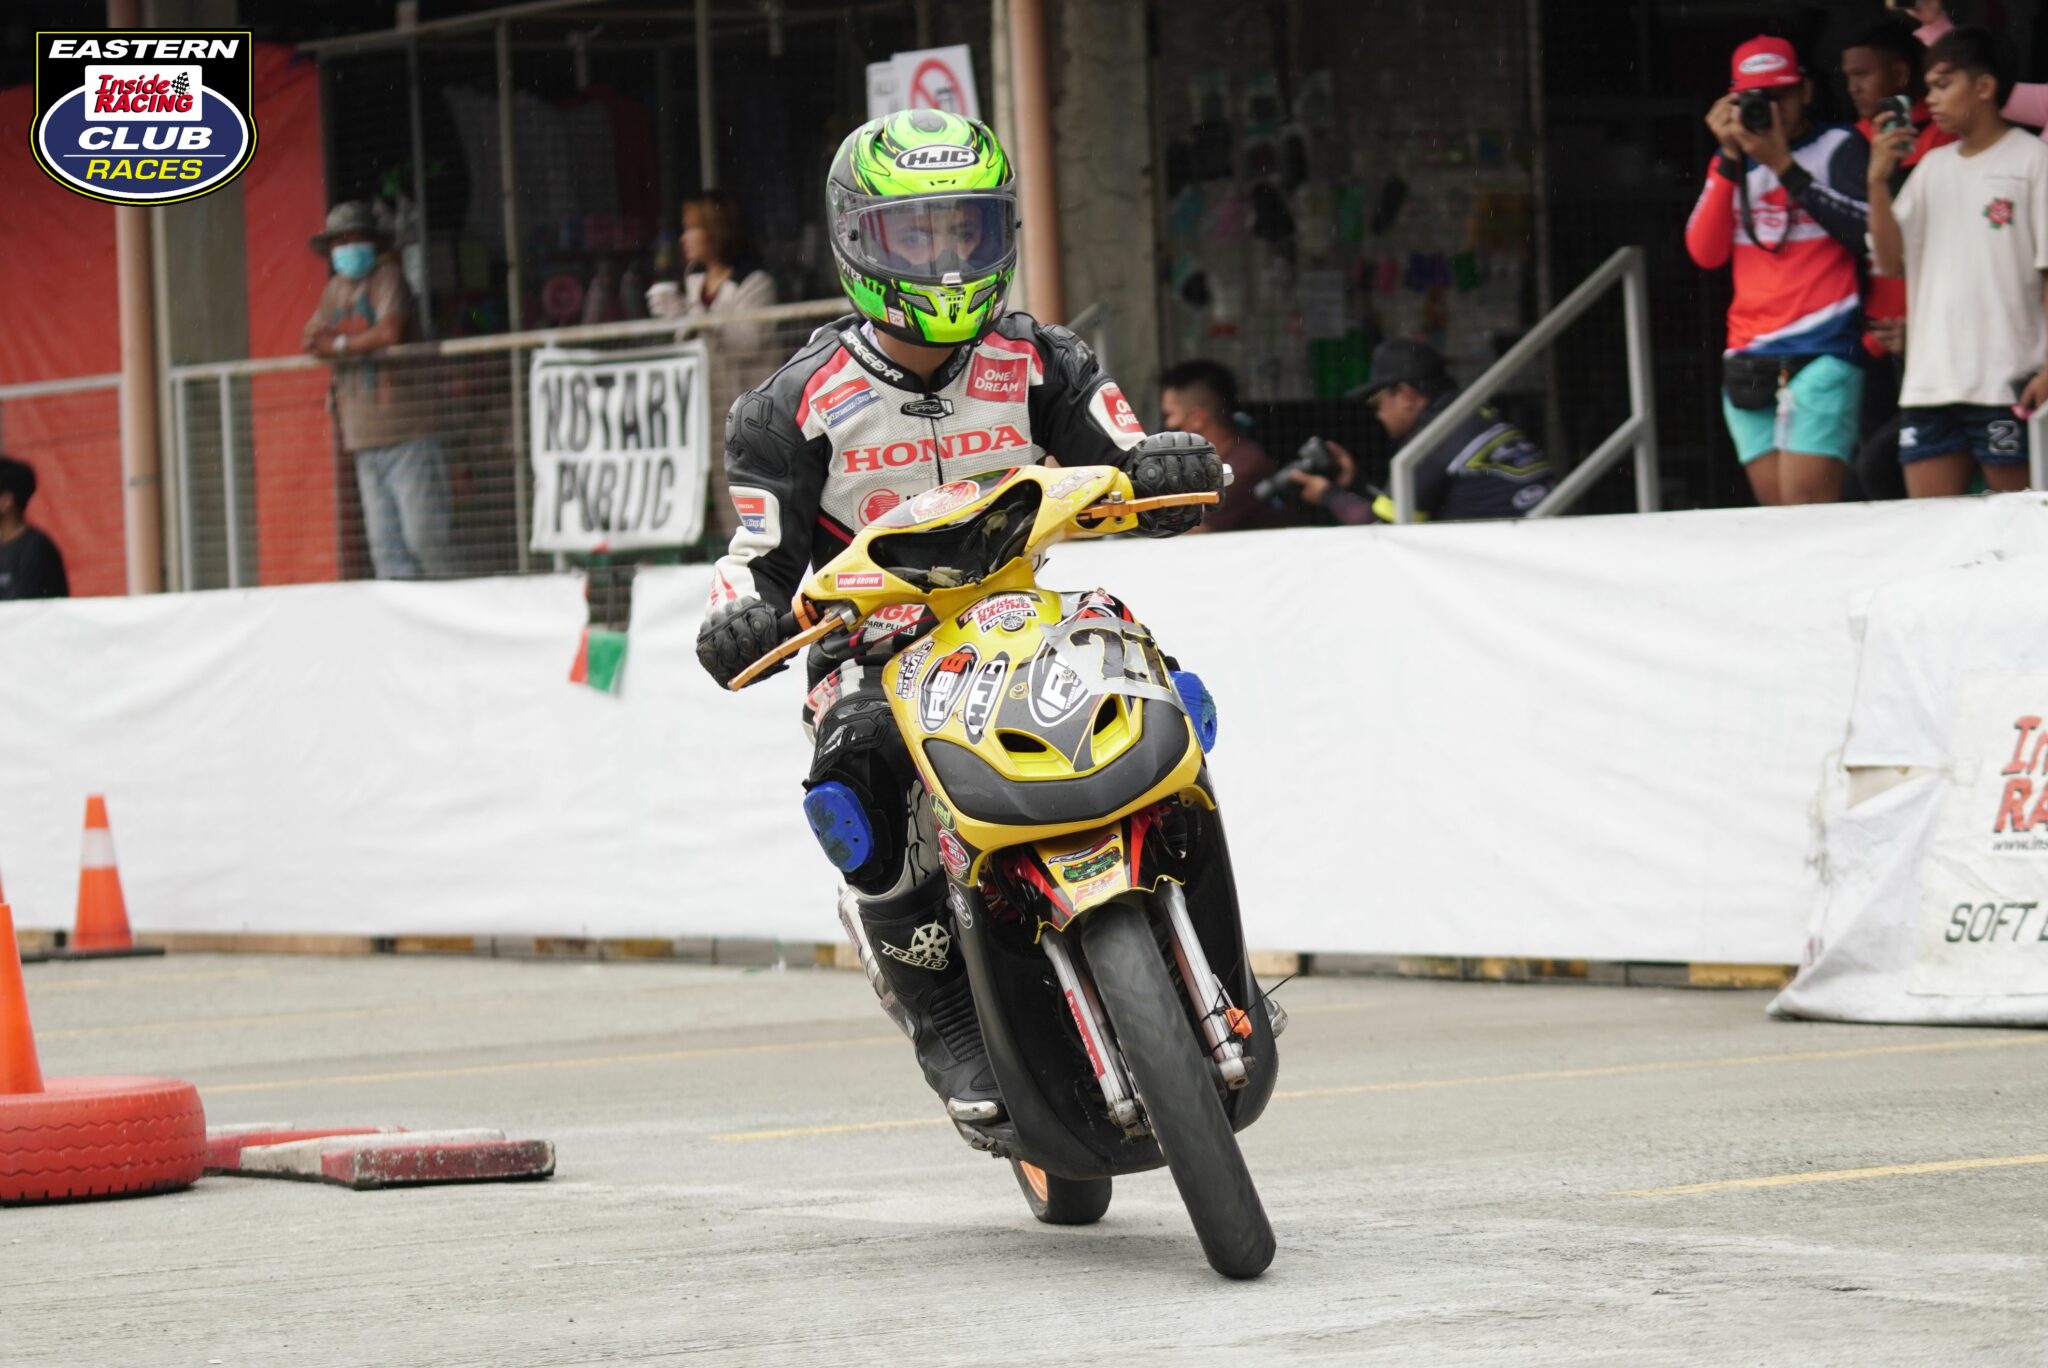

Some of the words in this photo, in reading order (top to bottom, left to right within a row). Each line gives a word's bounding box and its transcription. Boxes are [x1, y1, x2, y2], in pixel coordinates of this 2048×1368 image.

[906, 150, 970, 167] HJC
[541, 367, 694, 452] NOTARY
[1115, 414, 1140, 427] DRE
[843, 424, 1029, 474] HONDA
[555, 457, 676, 533] PUBLIC
[863, 620, 885, 629] PARK
[968, 659, 1006, 729] HJC
[1945, 901, 2039, 943] SOFT
